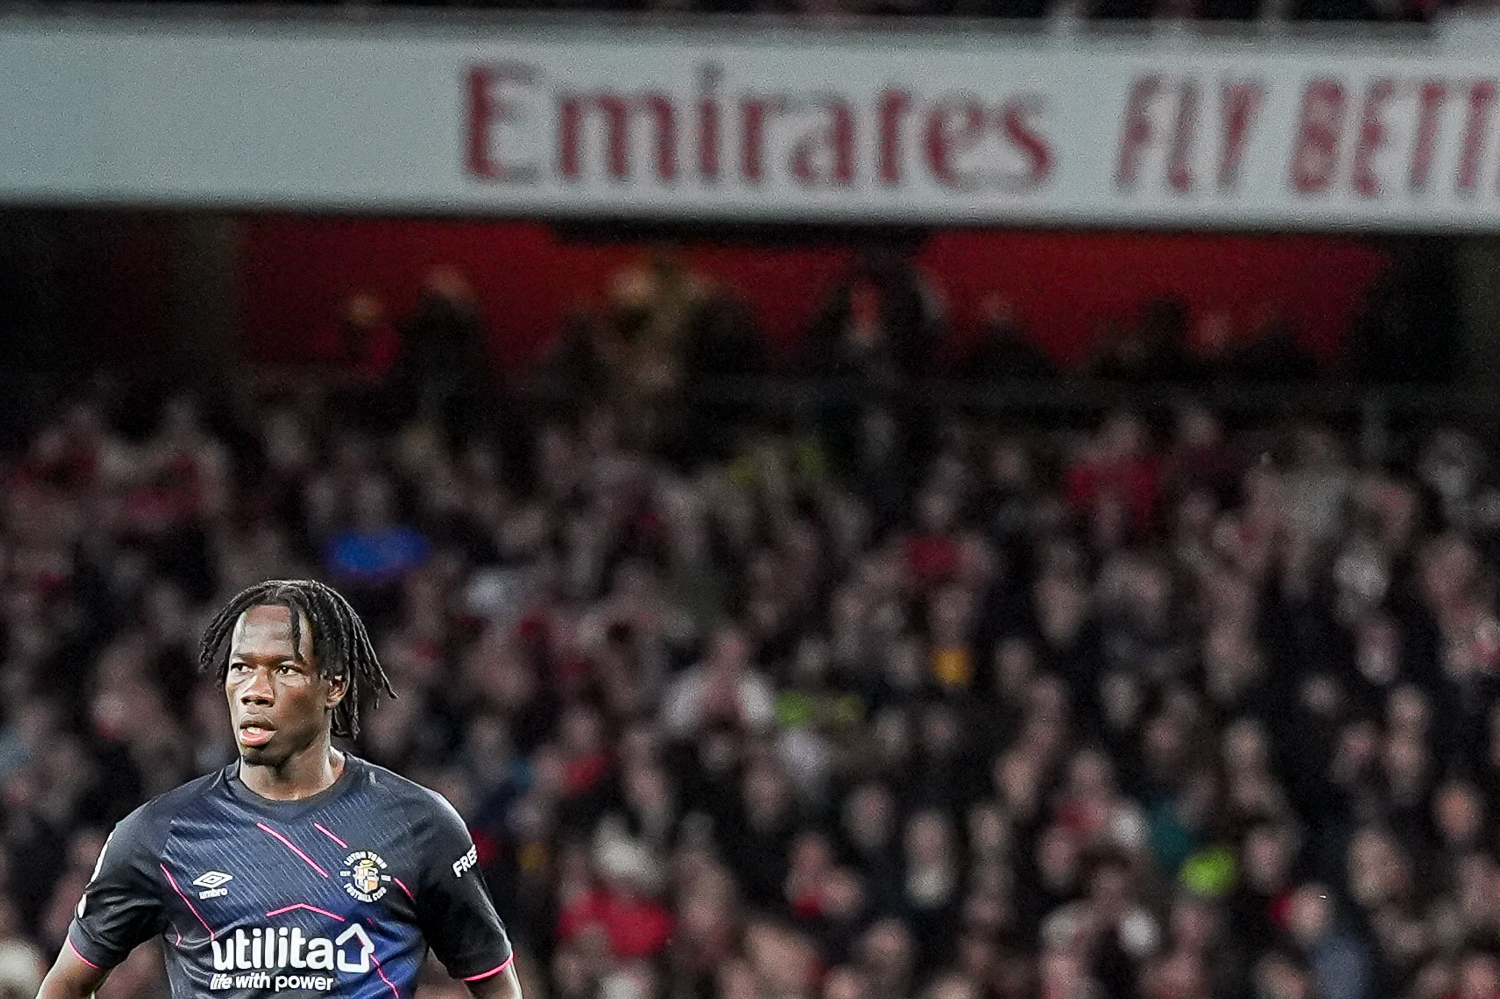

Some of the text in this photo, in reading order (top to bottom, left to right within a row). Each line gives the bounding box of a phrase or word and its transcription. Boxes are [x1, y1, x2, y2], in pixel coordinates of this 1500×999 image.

[462, 62, 1054, 188] Emirates
[1116, 74, 1267, 194] FLY
[211, 927, 334, 971] utilita
[210, 972, 333, 992] life with power
